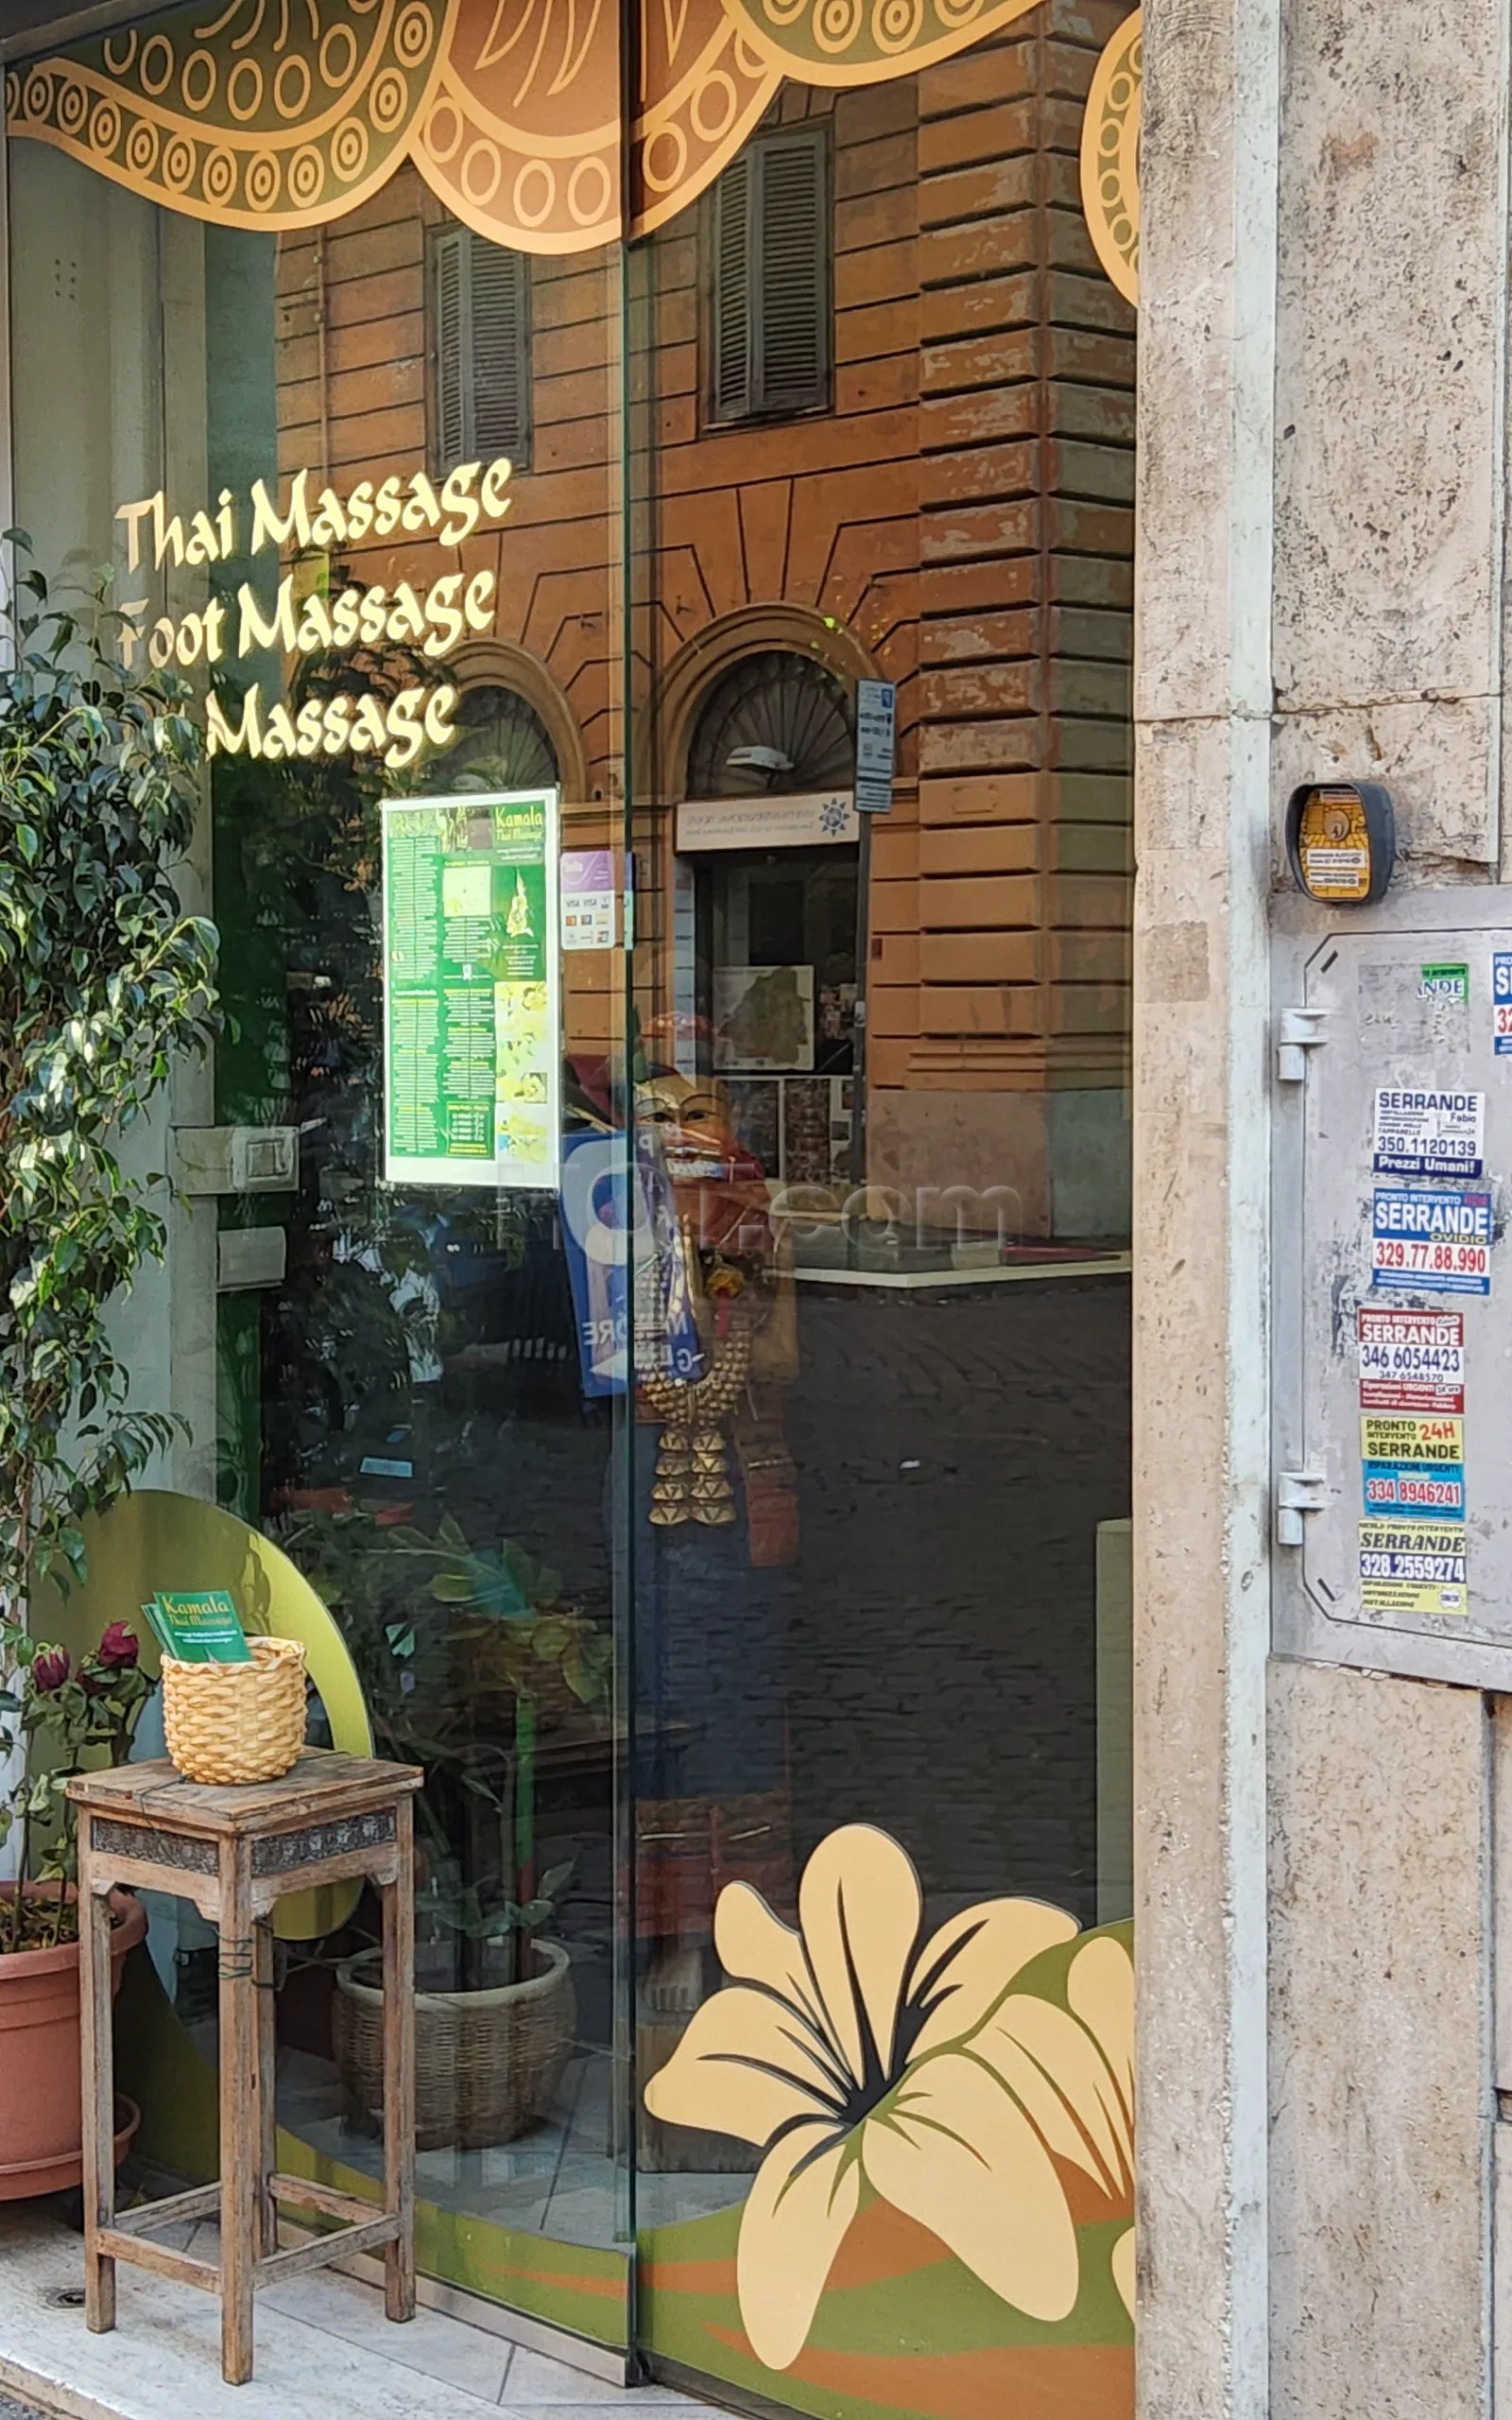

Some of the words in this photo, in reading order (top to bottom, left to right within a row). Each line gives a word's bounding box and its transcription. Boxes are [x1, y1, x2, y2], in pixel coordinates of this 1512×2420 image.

[114, 487, 232, 575] Thai
[251, 458, 512, 556] Massage
[115, 596, 225, 669] Foot
[238, 570, 496, 658] Massage
[205, 683, 456, 769] Massage
[495, 805, 542, 828] Kamala
[1380, 1092, 1478, 1112] SERRANDE
[1450, 1113, 1477, 1123] Fabio
[1378, 1135, 1476, 1156] 350.1120139
[1380, 1156, 1420, 1169] Prezzi
[1424, 1158, 1475, 1173] Umani!
[1375, 1201, 1488, 1236] SERRANDE
[1430, 1233, 1487, 1245] OVIDIO
[1376, 1241, 1486, 1273] 329.77.88.990
[1363, 1324, 1459, 1346] SERRANDE
[1362, 1344, 1389, 1368] 346
[1394, 1346, 1460, 1373] 6054423
[1380, 1370, 1397, 1379] 347
[1366, 1420, 1417, 1432] PRONTO
[1419, 1421, 1455, 1442] 24H
[1366, 1431, 1417, 1441] INTERVENTO
[1367, 1442, 1460, 1460] SERRANDE
[1368, 1479, 1395, 1501] 334
[1399, 1481, 1460, 1505] 8946241
[1361, 1532, 1467, 1553] SERRANDE
[1361, 1553, 1465, 1582] 328.2559274
[162, 1595, 229, 1614] Kamala
[168, 1614, 189, 1626] Thai
